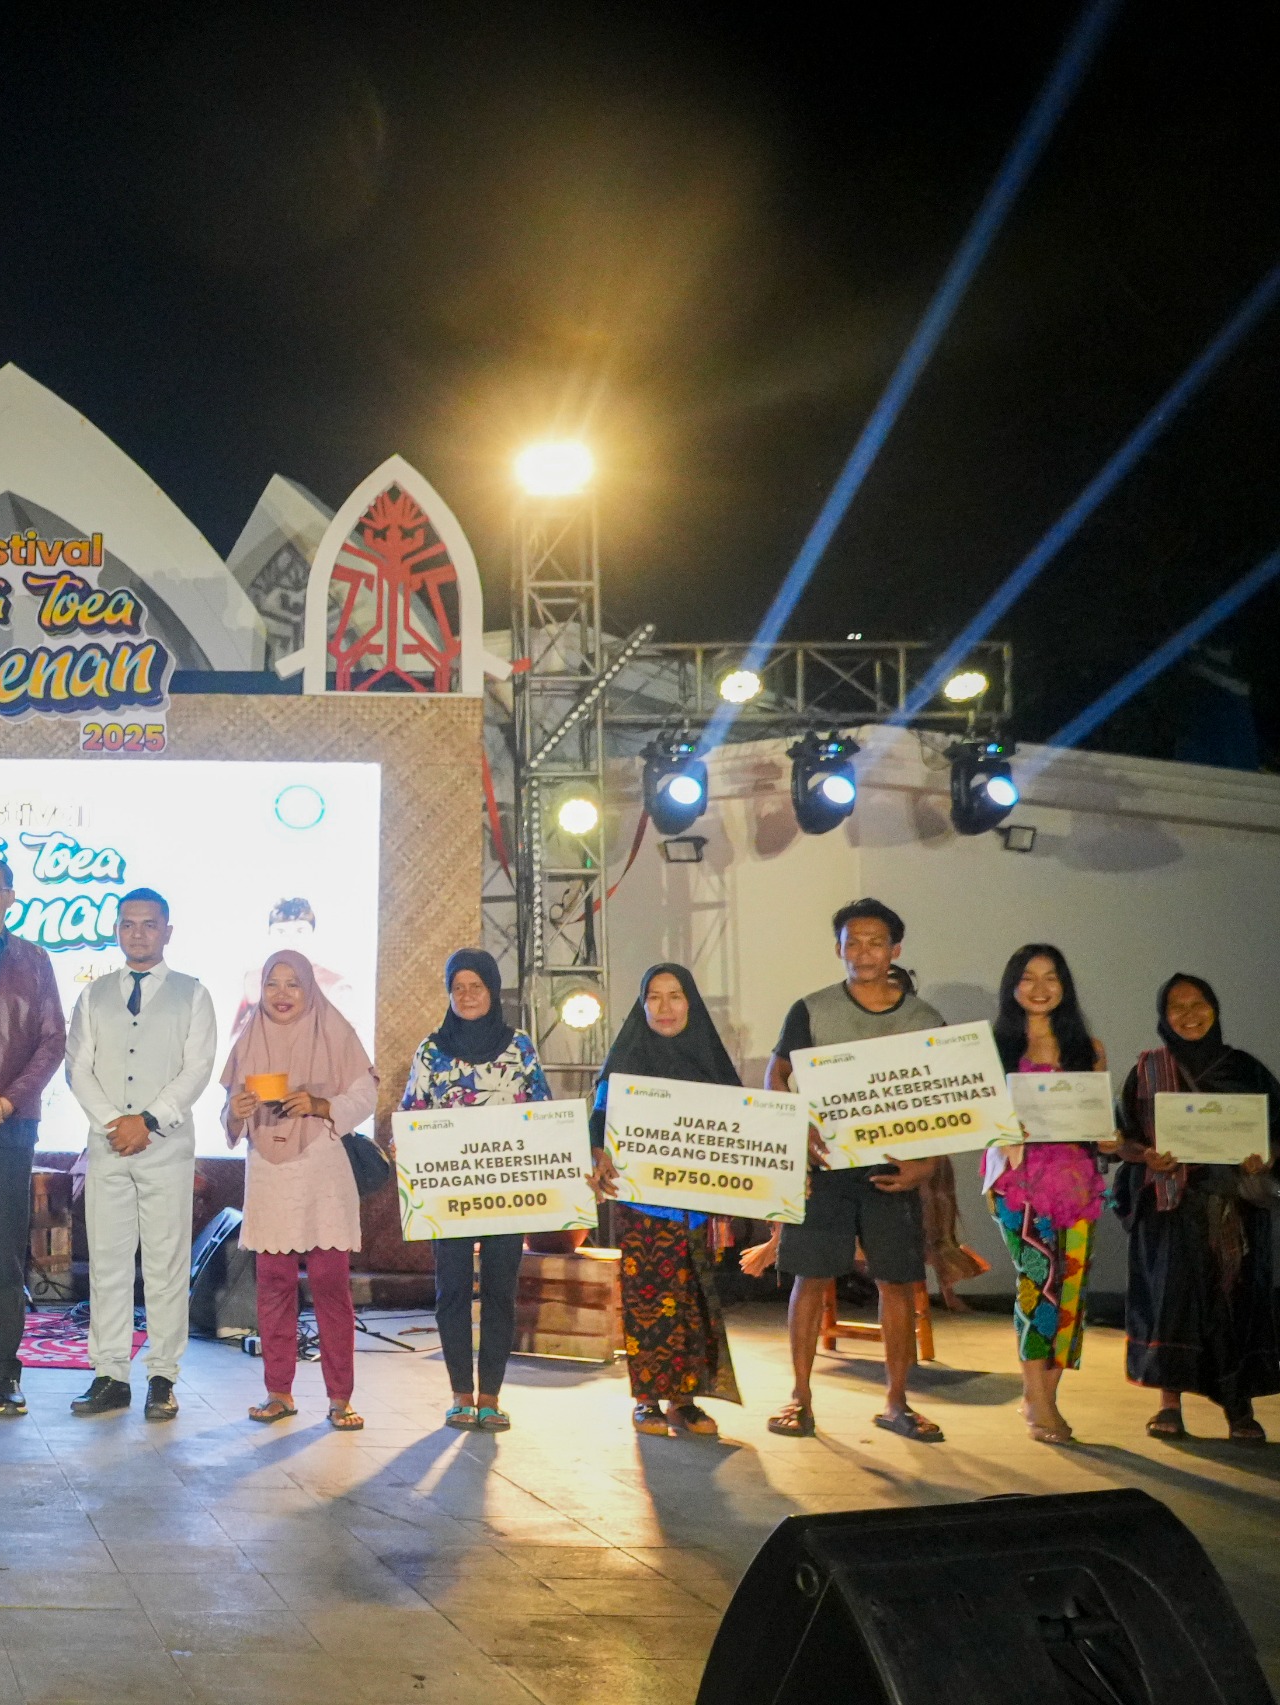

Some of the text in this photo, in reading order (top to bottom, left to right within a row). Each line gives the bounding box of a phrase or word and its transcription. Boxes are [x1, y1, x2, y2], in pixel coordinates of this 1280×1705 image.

[23, 571, 145, 637] Toea
[82, 722, 165, 752] 2025
[20, 831, 127, 885] Toea
[867, 1064, 931, 1085] JUARA 1
[633, 1089, 672, 1100] amanah
[822, 1072, 984, 1107] LOMBA KEBERSIHAN
[818, 1099, 908, 1124] PEDAGANG
[912, 1086, 997, 1109] DESTINASI
[417, 1119, 454, 1131] amanah
[673, 1116, 741, 1134] JUARA 2
[854, 1112, 972, 1144] Rp1.000.000
[460, 1139, 525, 1155] JUARA 3
[625, 1125, 787, 1155] LOMBA KEBERSIHAN
[416, 1152, 572, 1174] LOMBA KEBERSIHAN
[617, 1140, 794, 1172] PEDAGANG DESTINASI
[410, 1167, 581, 1190] PEDAGANG DESTINASI
[653, 1167, 754, 1191] Rp750.000
[448, 1192, 548, 1216] Rp500.000
